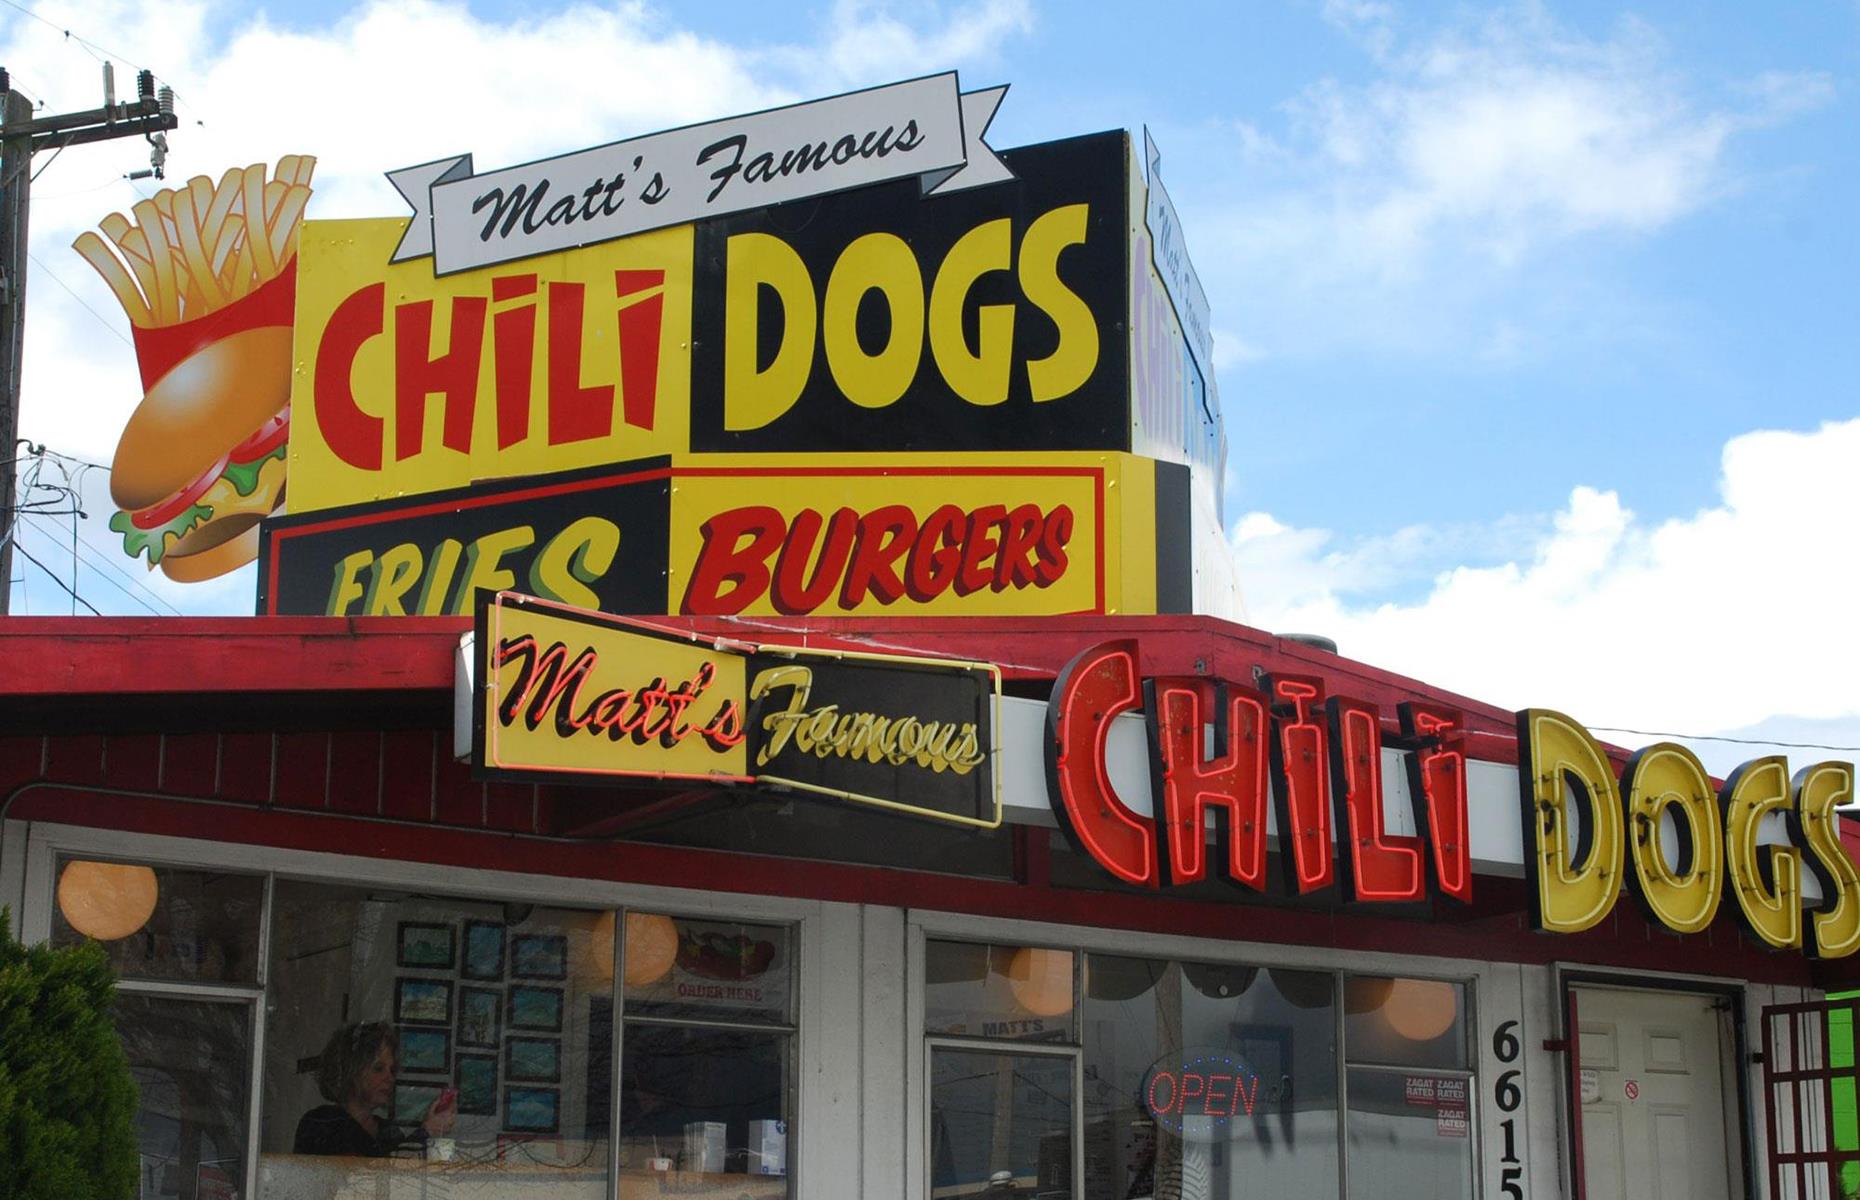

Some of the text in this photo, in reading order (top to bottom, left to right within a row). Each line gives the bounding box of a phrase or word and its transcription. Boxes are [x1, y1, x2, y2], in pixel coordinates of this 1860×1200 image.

[472, 118, 926, 242] Matt's Famous
[724, 203, 1099, 431] DOGS
[325, 516, 620, 616] FRIES
[680, 503, 1074, 616] BURGERS
[492, 634, 985, 775] Matt's Famous
[1516, 706, 1860, 959] DOGS
[982, 1019, 1044, 1037] MATT'S
[1148, 1071, 1259, 1117] OPEN
[1406, 1077, 1434, 1088] ZAGAT
[1406, 1087, 1434, 1097] RATED
[1437, 1080, 1464, 1089] ZAGAT
[1437, 1089, 1465, 1098] RATED
[1437, 1109, 1465, 1119] ZAGAT
[1438, 1119, 1466, 1128] RATED
[1492, 1020, 1523, 1200] 6615
